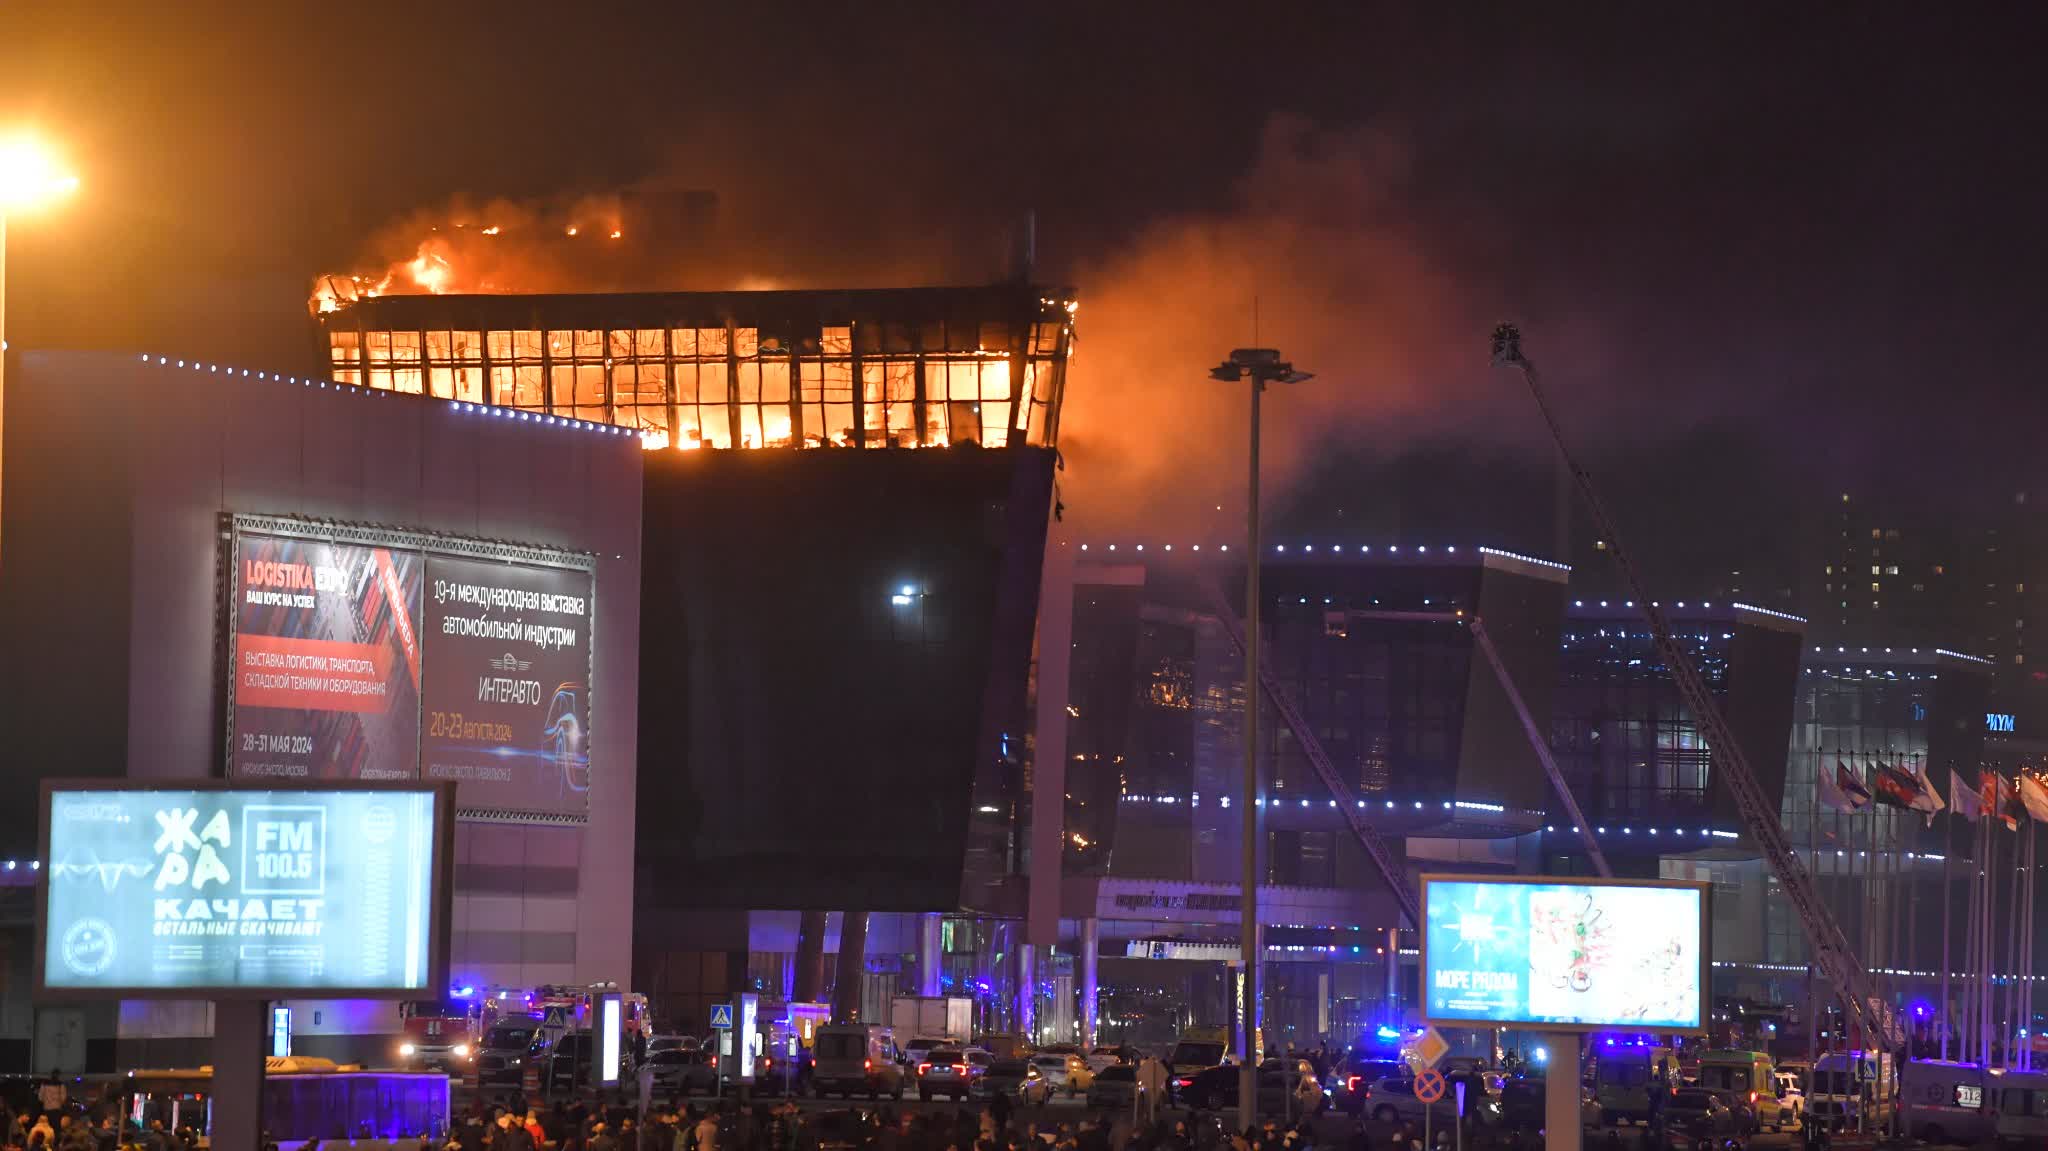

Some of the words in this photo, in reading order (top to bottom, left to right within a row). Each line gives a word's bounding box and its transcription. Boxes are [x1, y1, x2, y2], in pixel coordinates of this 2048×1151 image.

[246, 560, 314, 589] LOGISTIKA
[315, 566, 350, 593] EXPO
[246, 590, 264, 604] ВАШ
[264, 592, 282, 606] КУРС
[282, 593, 292, 607] НА
[293, 595, 315, 609] УСПЕХ
[434, 580, 456, 604] 19-я
[458, 583, 540, 612] международная
[541, 592, 585, 615] выставка
[443, 614, 522, 641] автомобильной
[524, 623, 576, 651] индустрии
[245, 652, 284, 666] ВЫСТАВКА
[285, 655, 328, 672] ЛОГИСТИКИ,
[329, 658, 375, 676] ТРАНСПОРТА,
[244, 672, 290, 690] СКЛАДСКОЙ
[291, 676, 321, 691] ТЕХНИКИ
[322, 678, 329, 691] И
[330, 678, 386, 696] ОБОРУДОВАНИЯ
[478, 677, 541, 705] ИНТЕРАВТО
[430, 711, 462, 739] 20-23
[494, 723, 512, 741] 2024
[242, 734, 268, 752] 28-31
[269, 736, 290, 753] МАЯ
[291, 736, 313, 754] 2024
[256, 821, 313, 851] FM
[256, 852, 313, 878] 100.5
[154, 898, 325, 920] КАЧАЕТ
[153, 920, 237, 936] ОСТАЛЬНЫЕ
[239, 921, 323, 936] СКАЧИВАЮТ
[1435, 969, 1471, 989] МОРЕ
[1472, 970, 1518, 992] РЯДОМ
